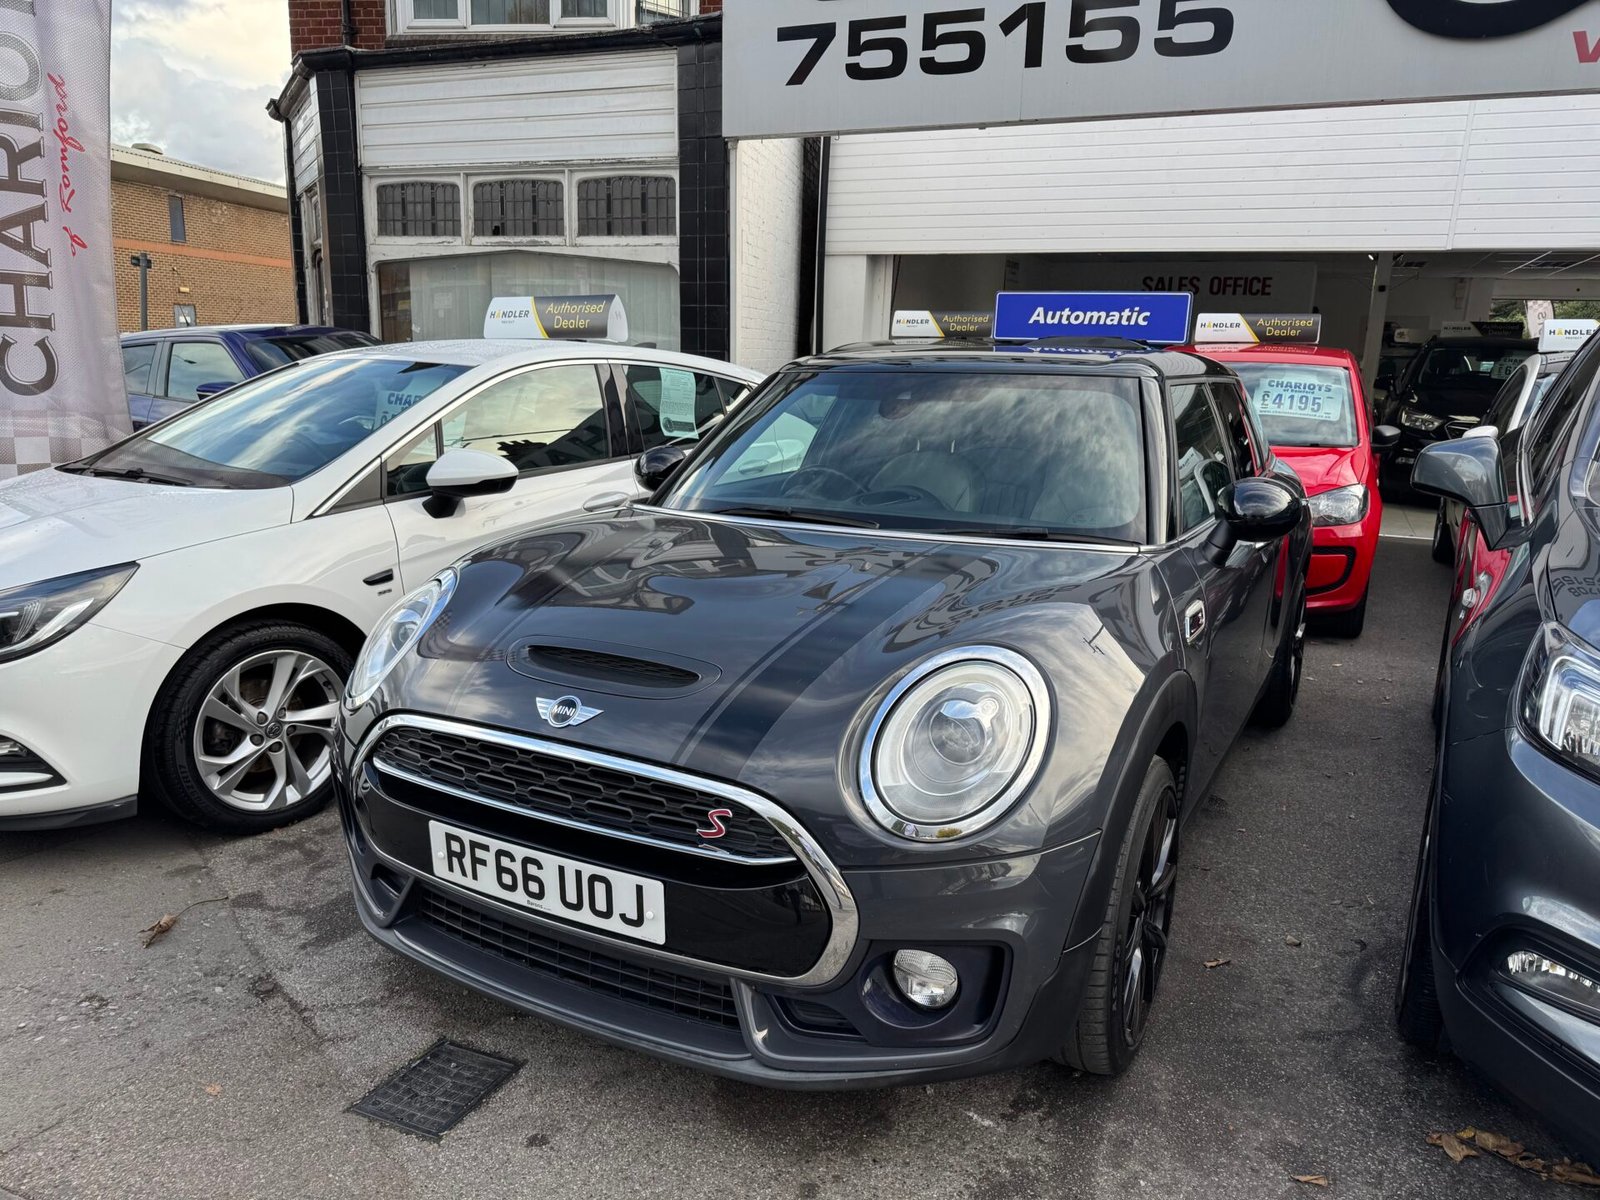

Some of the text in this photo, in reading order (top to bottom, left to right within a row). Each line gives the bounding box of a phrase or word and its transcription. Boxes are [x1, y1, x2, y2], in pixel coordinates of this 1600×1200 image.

[777, 0, 1235, 86] 755155
[47, 73, 88, 257] of Romford
[1142, 276, 1273, 297] SALES OFFICE
[546, 301, 605, 314] Authorised
[554, 315, 591, 329] Dealer
[942, 315, 989, 323] Authorised
[1028, 306, 1151, 327] Automatic
[1257, 318, 1314, 327] Authorised
[950, 323, 979, 331] Dealer
[1266, 327, 1302, 337] Dealer
[1268, 380, 1333, 392] CHARIOTS
[552, 704, 575, 716] MINI
[697, 809, 732, 838] S
[444, 831, 645, 928] RF66 UOJ
